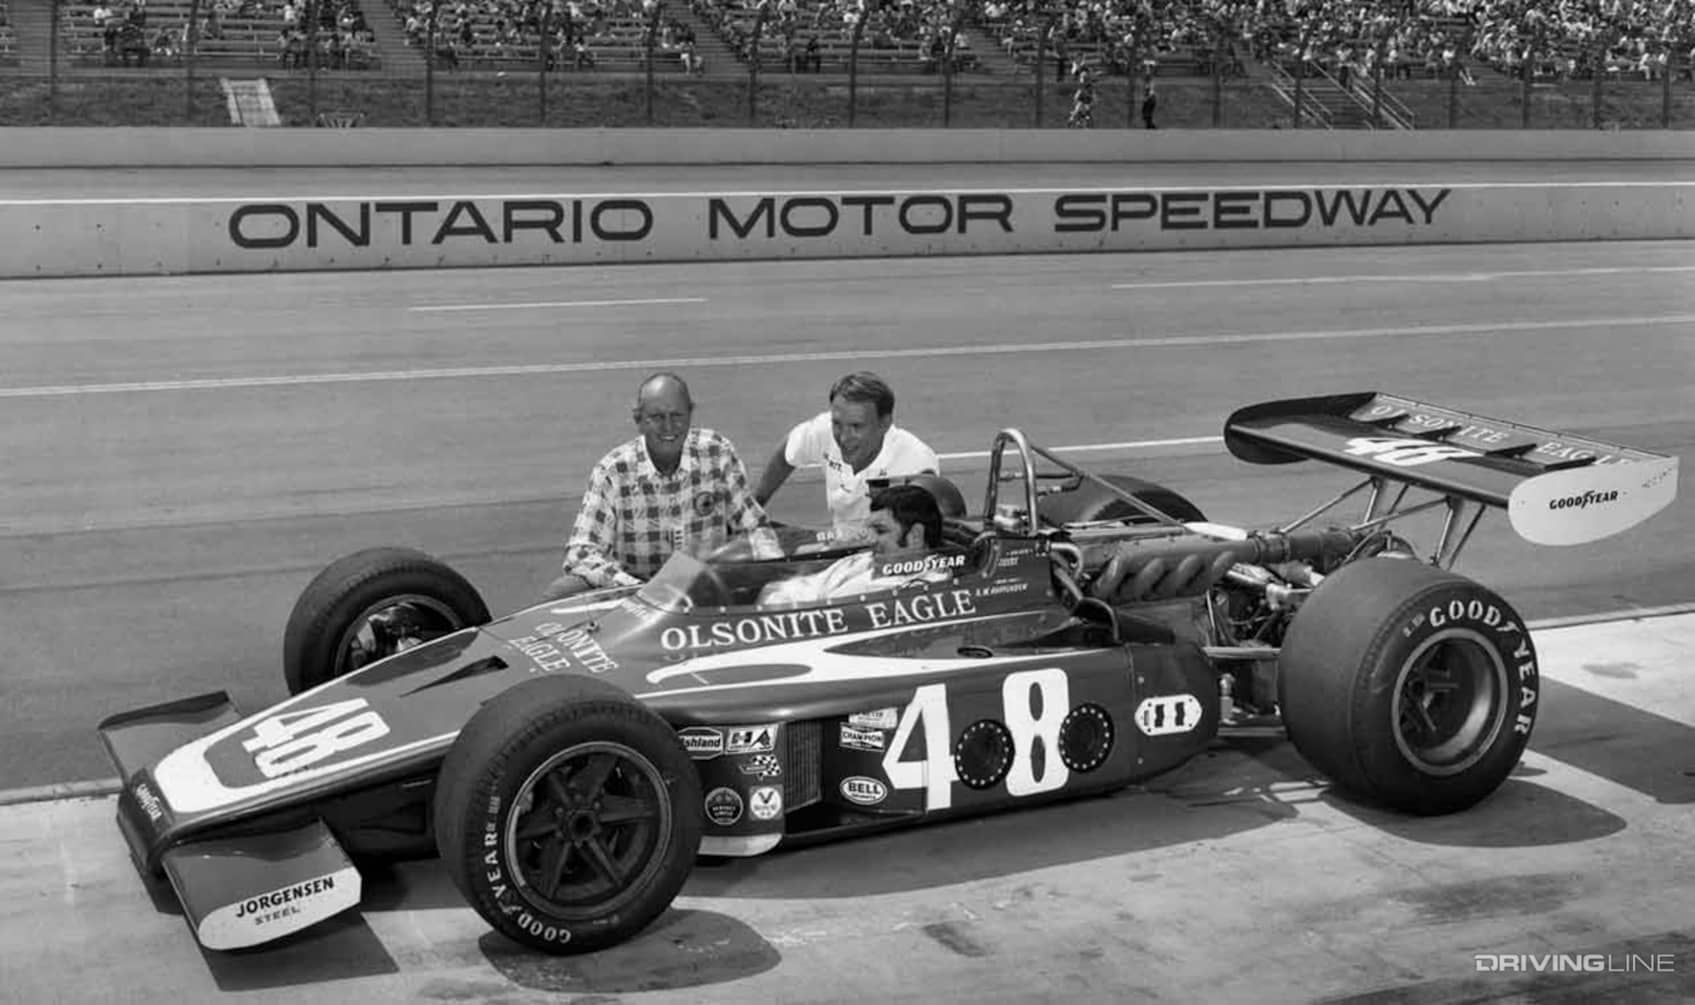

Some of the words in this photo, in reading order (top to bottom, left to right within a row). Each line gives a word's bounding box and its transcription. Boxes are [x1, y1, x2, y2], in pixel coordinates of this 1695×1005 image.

[229, 200, 653, 249] ONTARIO
[709, 194, 1013, 240] MOTOR
[1054, 188, 1452, 232] SPEEDWAY
[1344, 437, 1485, 467] 48
[1549, 490, 1618, 510] GOODYEAR
[882, 554, 966, 576] GOODYEAR
[660, 608, 848, 651] OLSONITE
[864, 588, 977, 630] EAGLE
[535, 622, 620, 673] OLONITE
[1429, 599, 1536, 735] GOODYEAR
[242, 697, 391, 779] 48
[882, 668, 1070, 812] 48
[848, 782, 882, 795] BELL
[235, 876, 335, 918] JORGENSEN
[484, 832, 572, 943] GOODYEAR
[254, 906, 302, 926] STEEL
